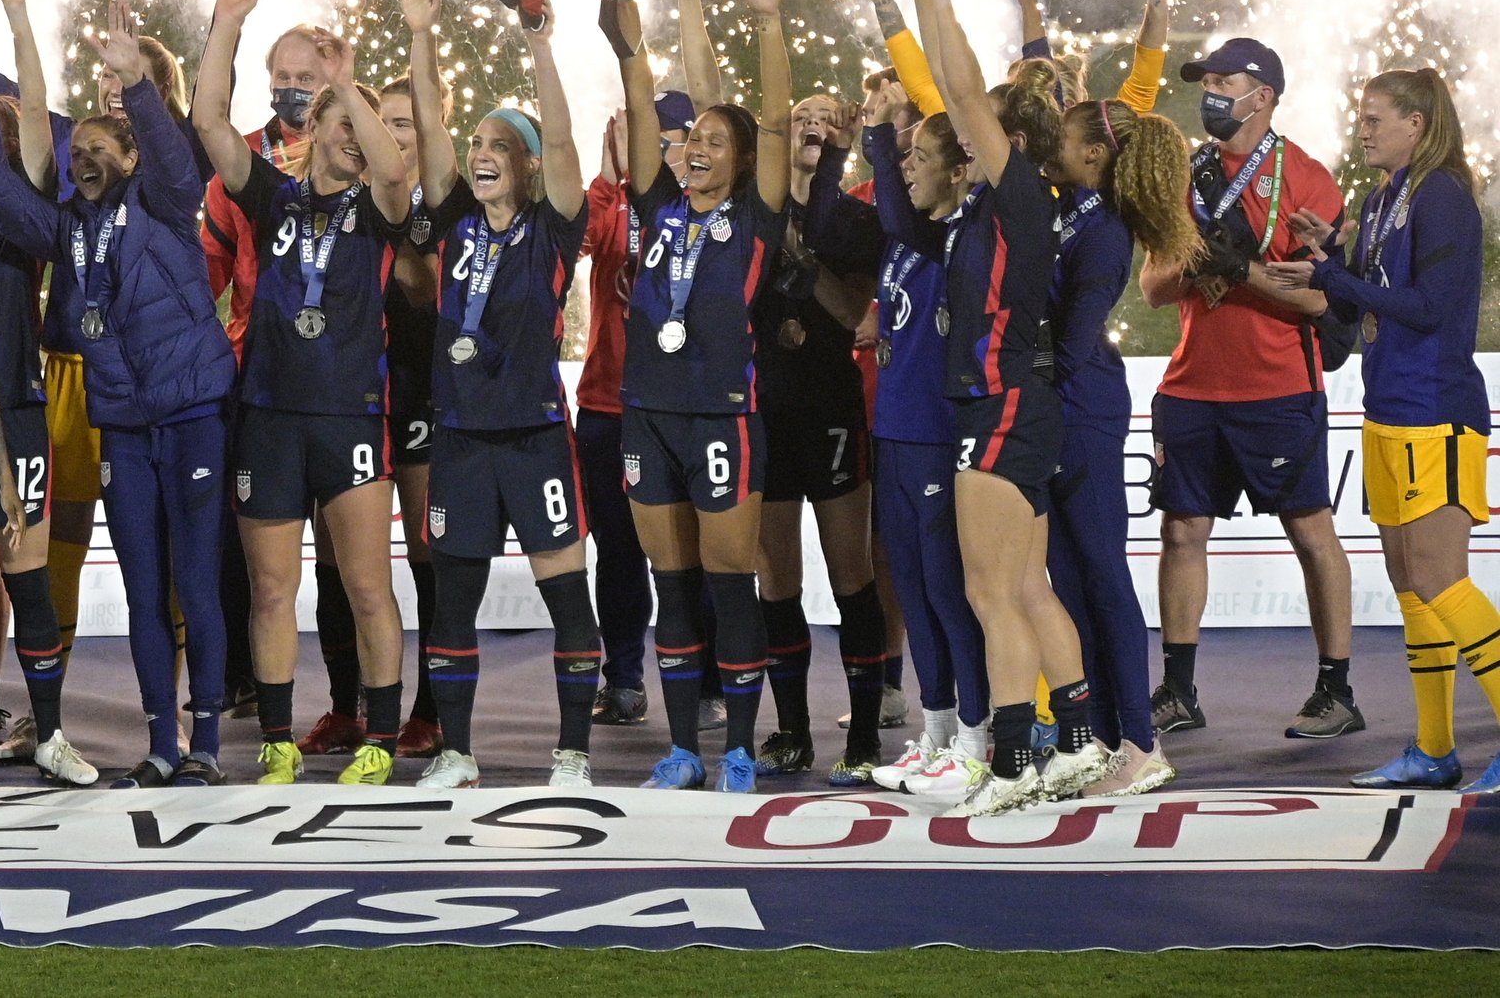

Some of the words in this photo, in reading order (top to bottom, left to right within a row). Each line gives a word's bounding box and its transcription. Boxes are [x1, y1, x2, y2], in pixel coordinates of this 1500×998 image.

[1212, 151, 1263, 219] SHEBELIEVESCUP
[1257, 131, 1276, 154] 2021
[1078, 193, 1102, 214] 2021
[273, 215, 297, 258] 9
[314, 197, 350, 269] SHEBELIEVESCUP
[412, 221, 430, 230] USA
[630, 230, 638, 252] 2021
[711, 220, 728, 231] USA
[73, 241, 85, 266] 2021
[302, 238, 312, 262] 2021
[644, 227, 674, 269] 6
[671, 256, 681, 281] 2021
[882, 262, 894, 286] 2021
[405, 420, 435, 451] 2
[827, 428, 848, 471] 7
[15, 456, 46, 500] 12
[352, 443, 374, 482] 9
[625, 460, 640, 470] USA
[707, 441, 731, 484] 6
[1404, 442, 1415, 484] 1
[543, 477, 569, 523] 8
[430, 513, 445, 524] USA
[725, 794, 1322, 850] CUP
